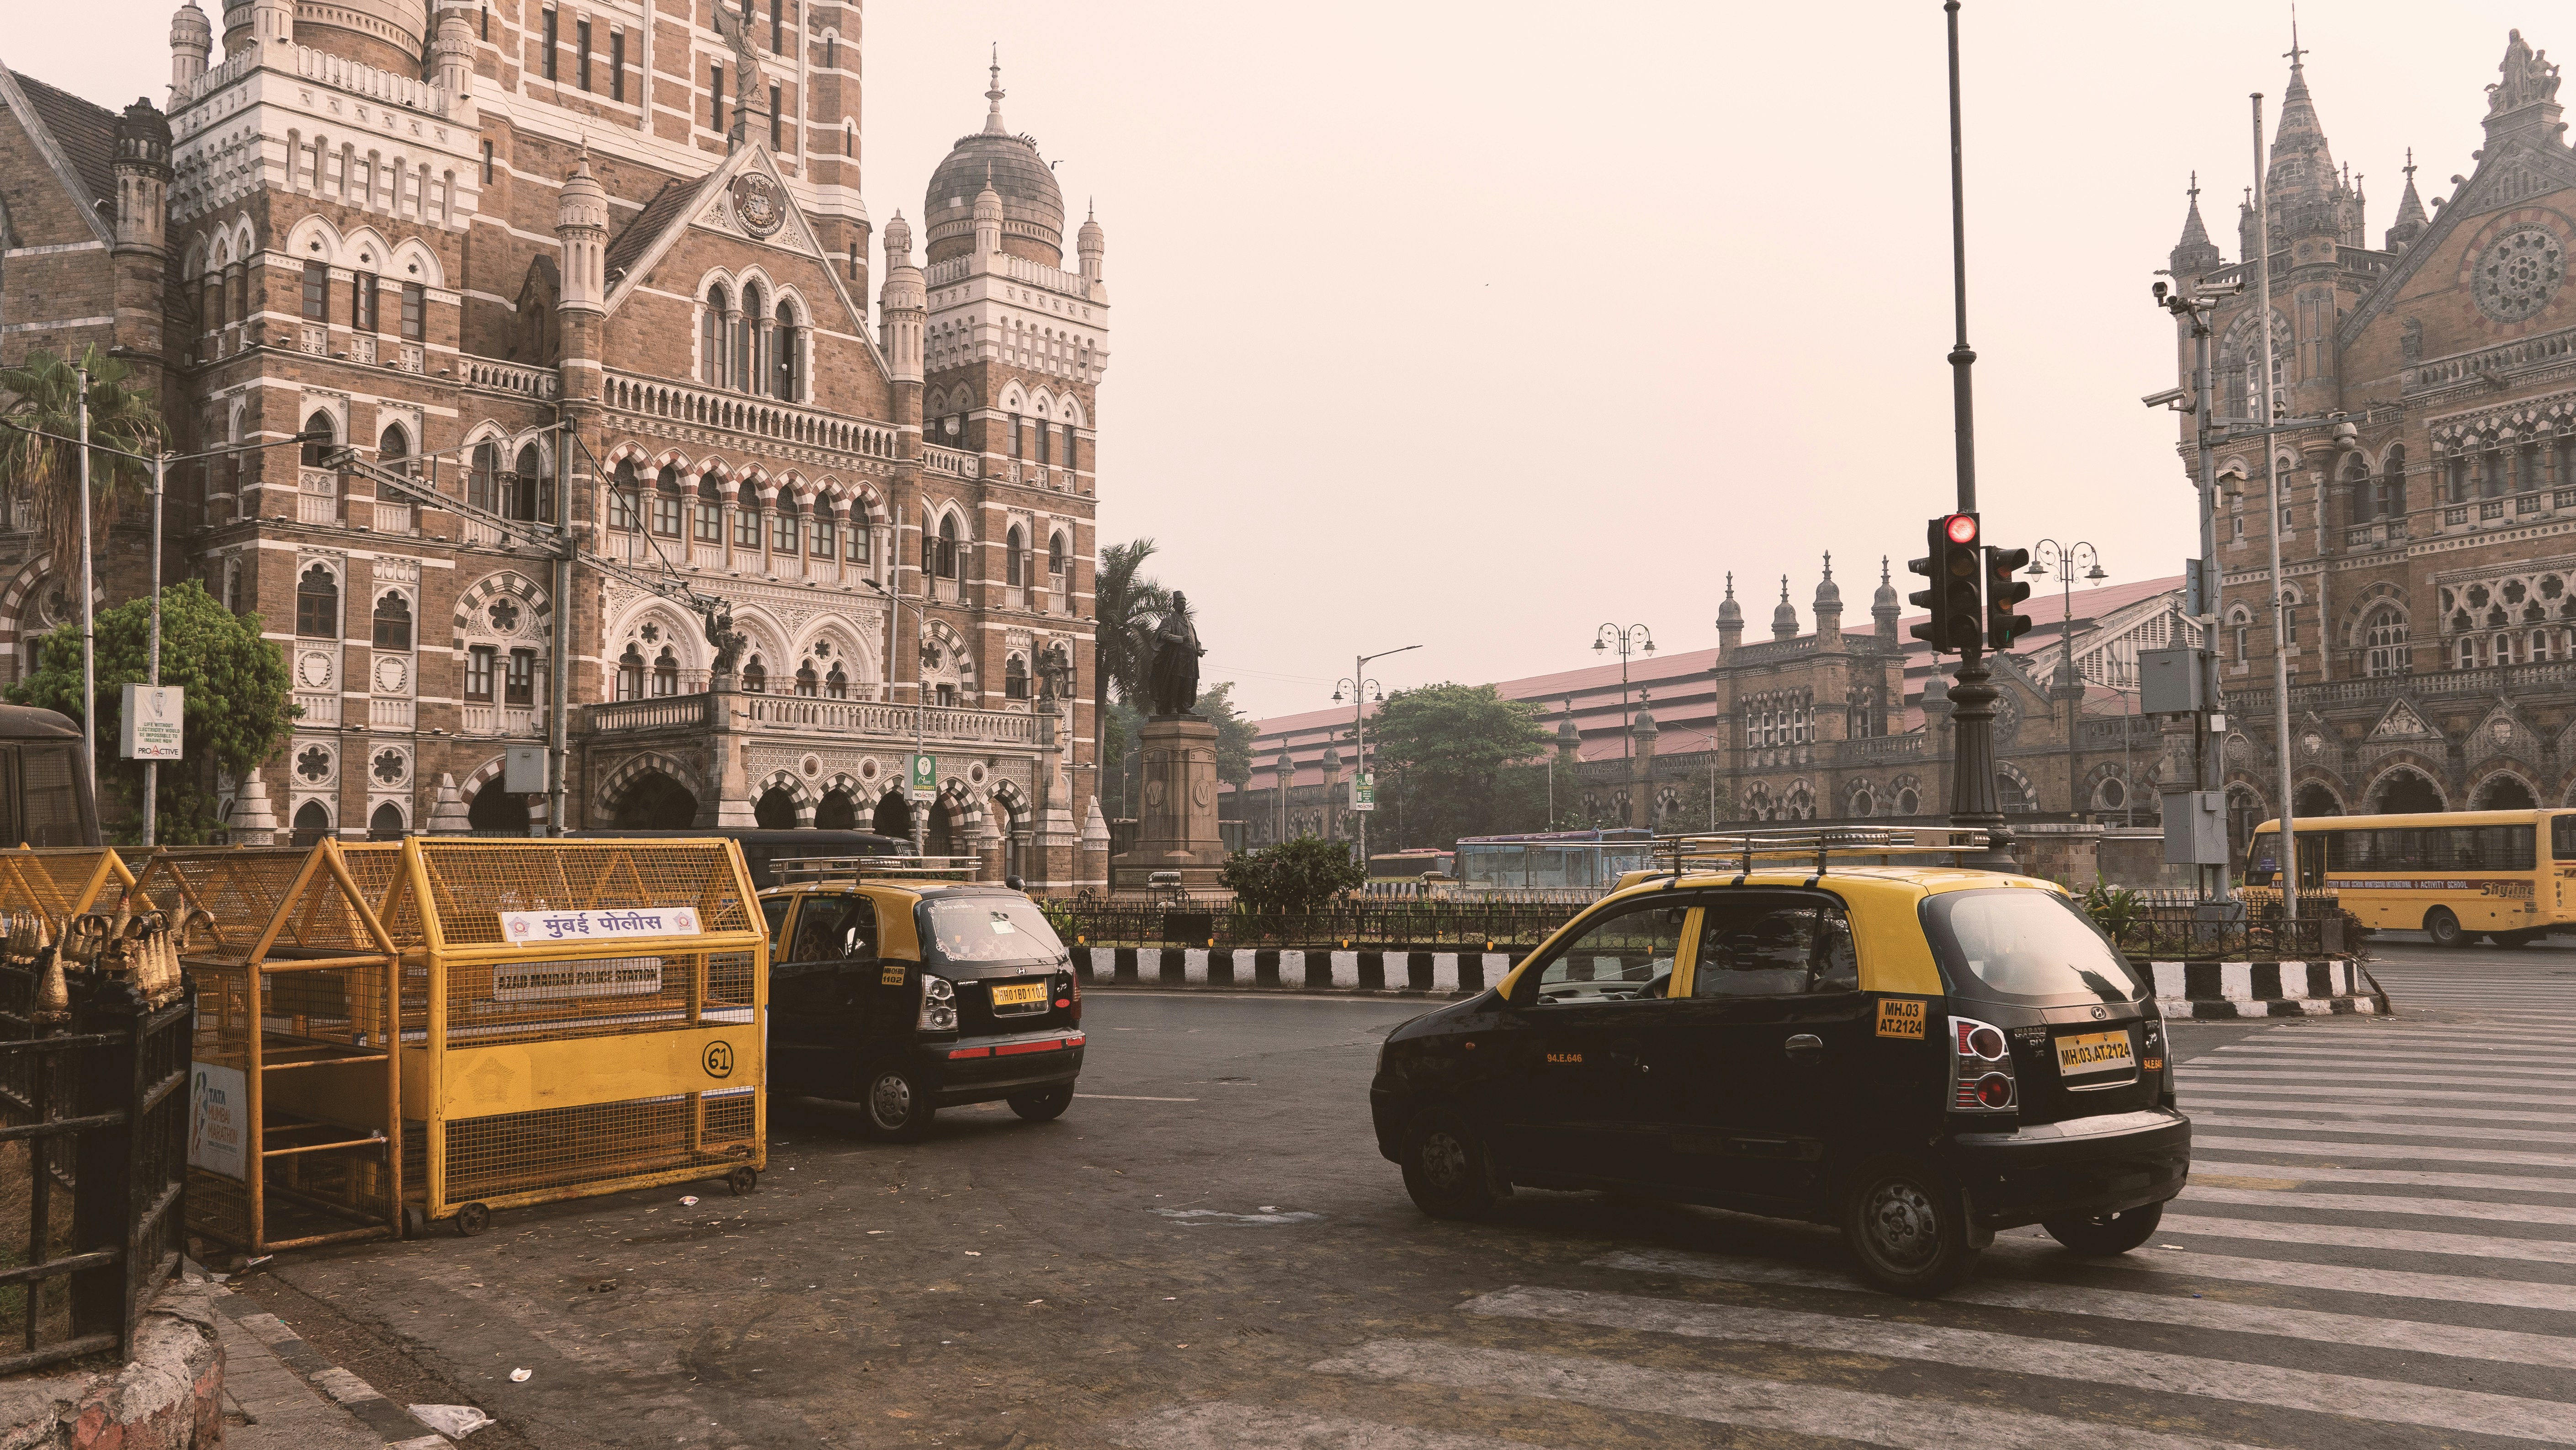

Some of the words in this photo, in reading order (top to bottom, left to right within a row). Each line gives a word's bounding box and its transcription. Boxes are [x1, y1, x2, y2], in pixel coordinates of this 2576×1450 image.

[138, 745, 179, 756] PROACTIVE
[918, 776, 931, 785] Save
[2421, 880, 2444, 889] ACTIVITY
[2447, 880, 2468, 889] SCHOOL
[2480, 882, 2534, 897] Skyline
[543, 912, 590, 938] मुंबई
[598, 912, 662, 931] पोलीस
[576, 970, 613, 984] POLICE
[615, 968, 658, 983] STATION
[1885, 1002, 1919, 1017] MH.03
[1880, 1018, 1922, 1034] AT.2124
[708, 1048, 729, 1070] 61
[1547, 1054, 1582, 1062] 94.E.646
[2061, 1043, 2131, 1066] MH.03.AT.2124
[2144, 1059, 2162, 1069] 94.E.646
[208, 1088, 226, 1105] TATA
[208, 1104, 230, 1125] MUMBAI
[207, 1122, 238, 1146] MARATHON
